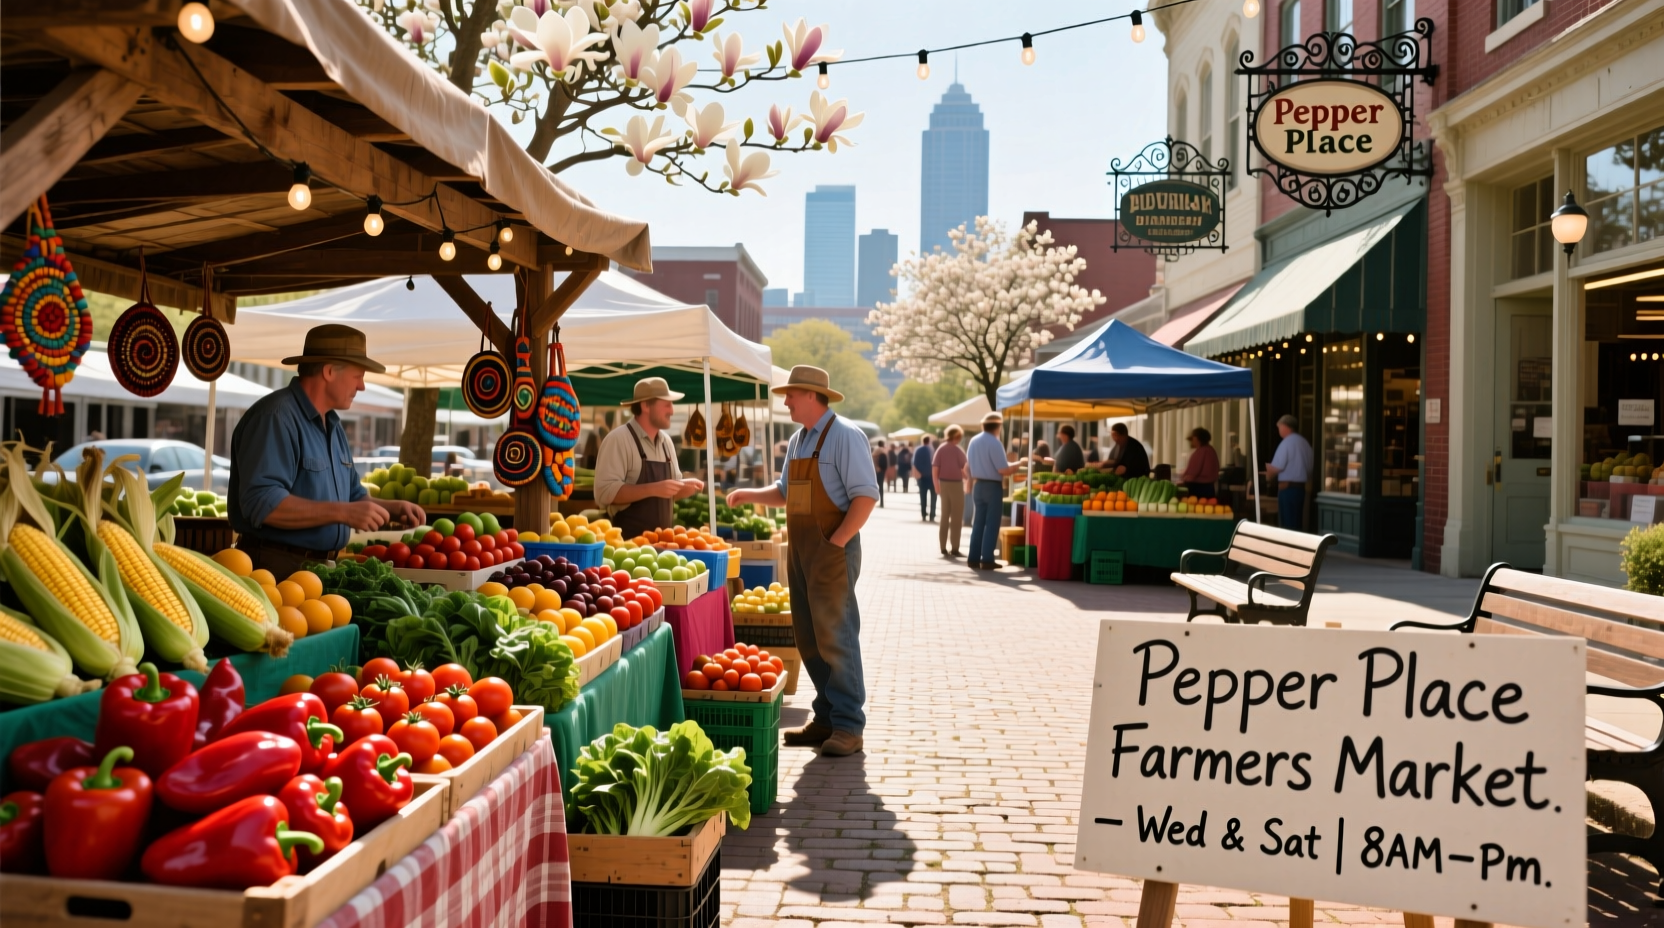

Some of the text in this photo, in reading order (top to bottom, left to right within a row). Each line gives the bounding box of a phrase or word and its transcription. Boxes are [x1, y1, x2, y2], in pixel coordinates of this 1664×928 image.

[1273, 98, 1385, 131] Pepper
[1284, 129, 1373, 154] Place
[1132, 638, 1530, 735] Pepper Place
[1111, 722, 1562, 814] Farmers Market.
[1136, 804, 1208, 849] Wed
[1220, 817, 1245, 853] &
[1259, 817, 1322, 861] Sat
